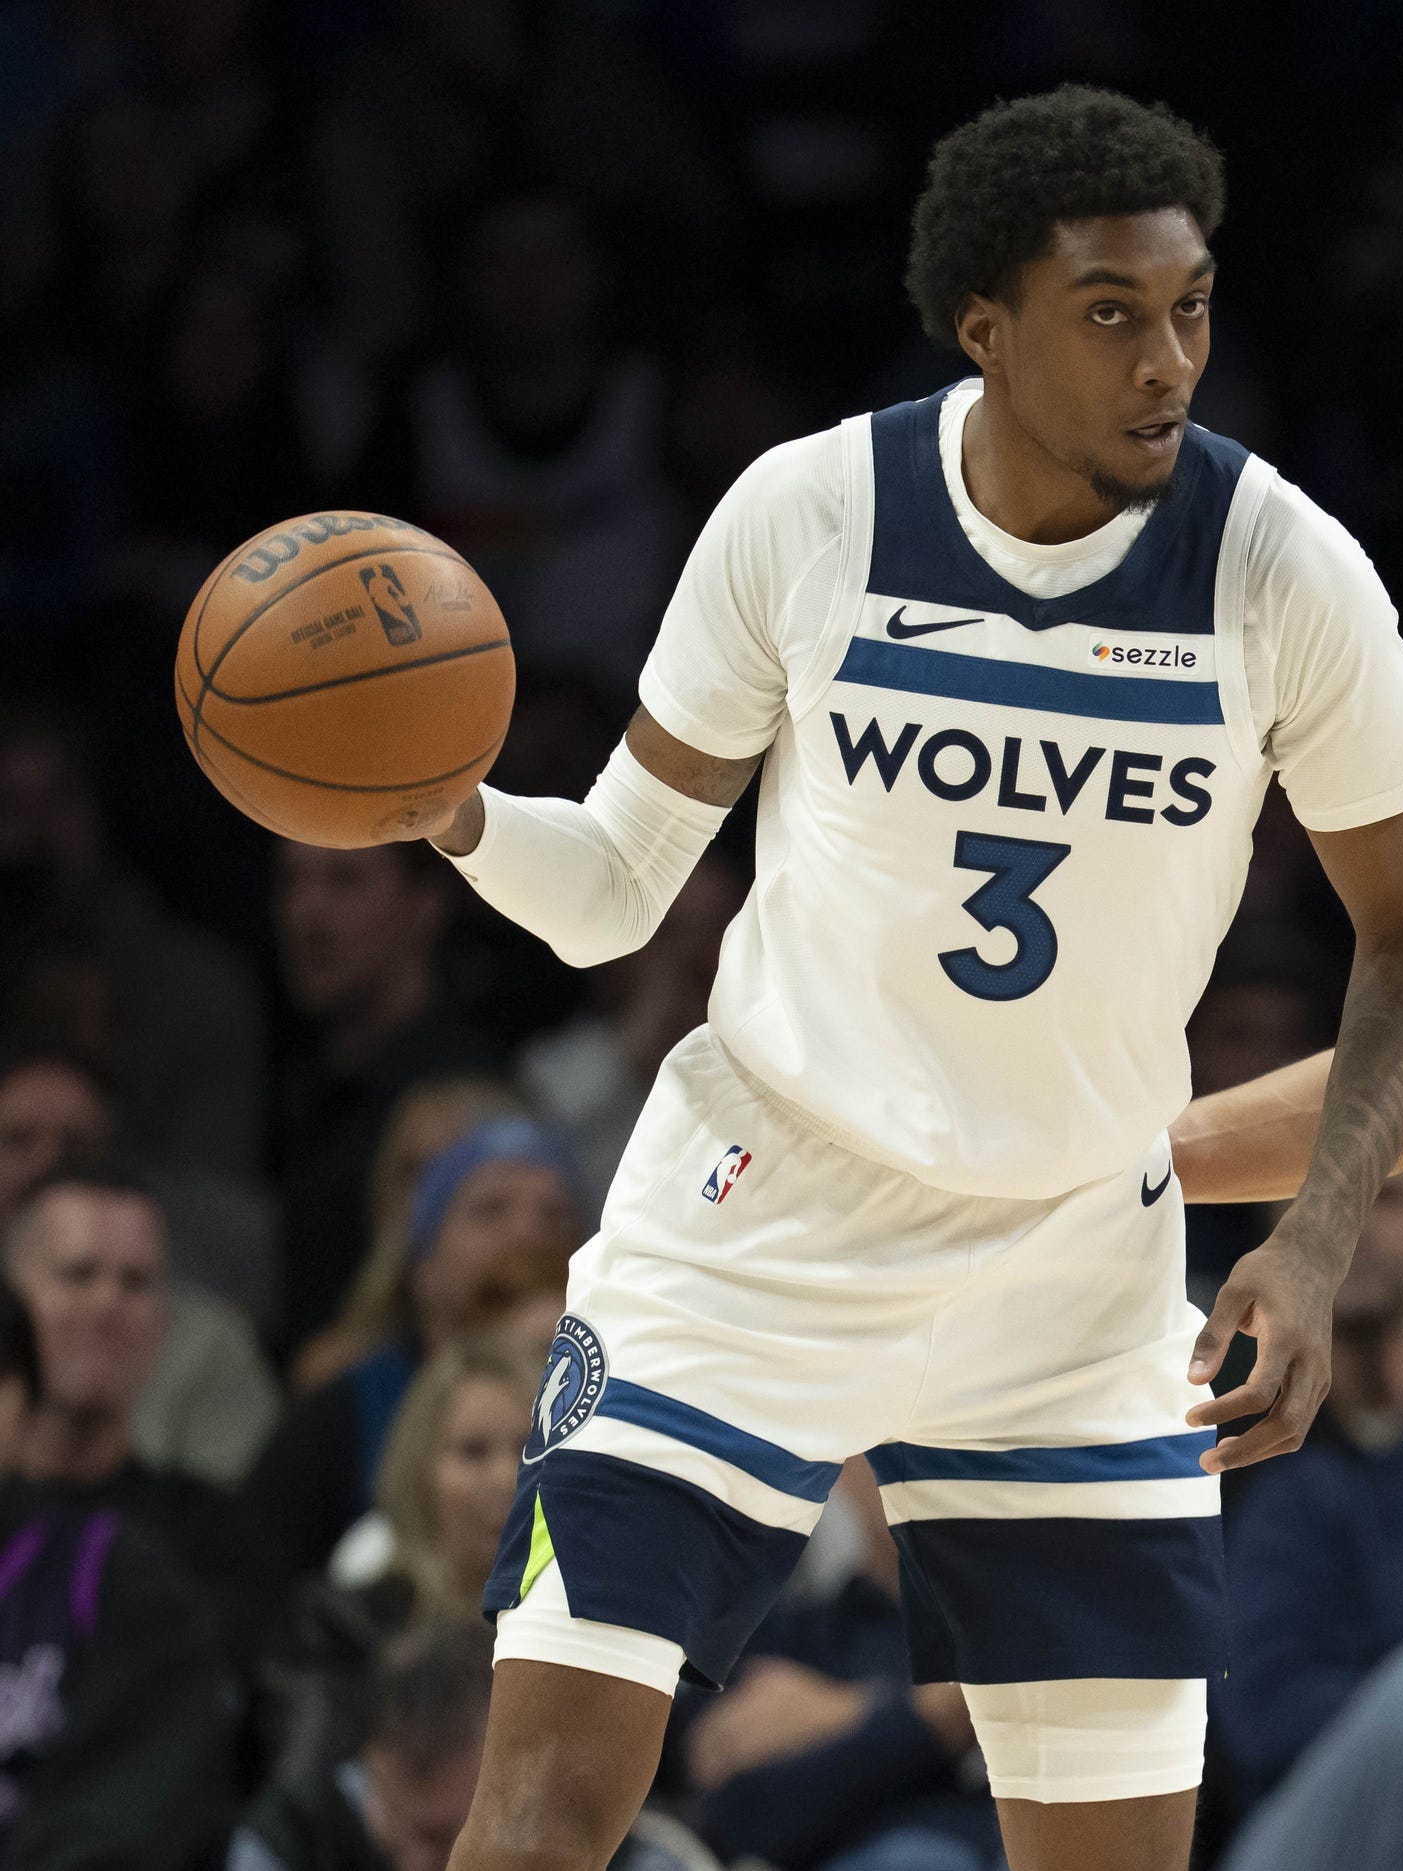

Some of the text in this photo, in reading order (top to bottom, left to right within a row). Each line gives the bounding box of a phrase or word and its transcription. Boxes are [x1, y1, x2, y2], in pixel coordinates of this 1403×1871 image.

[1111, 645, 1197, 668] sezzle
[829, 711, 1217, 827] WOLVES
[937, 830, 1072, 1002] 3
[560, 1319, 602, 1436] TIMBERWOLVES
